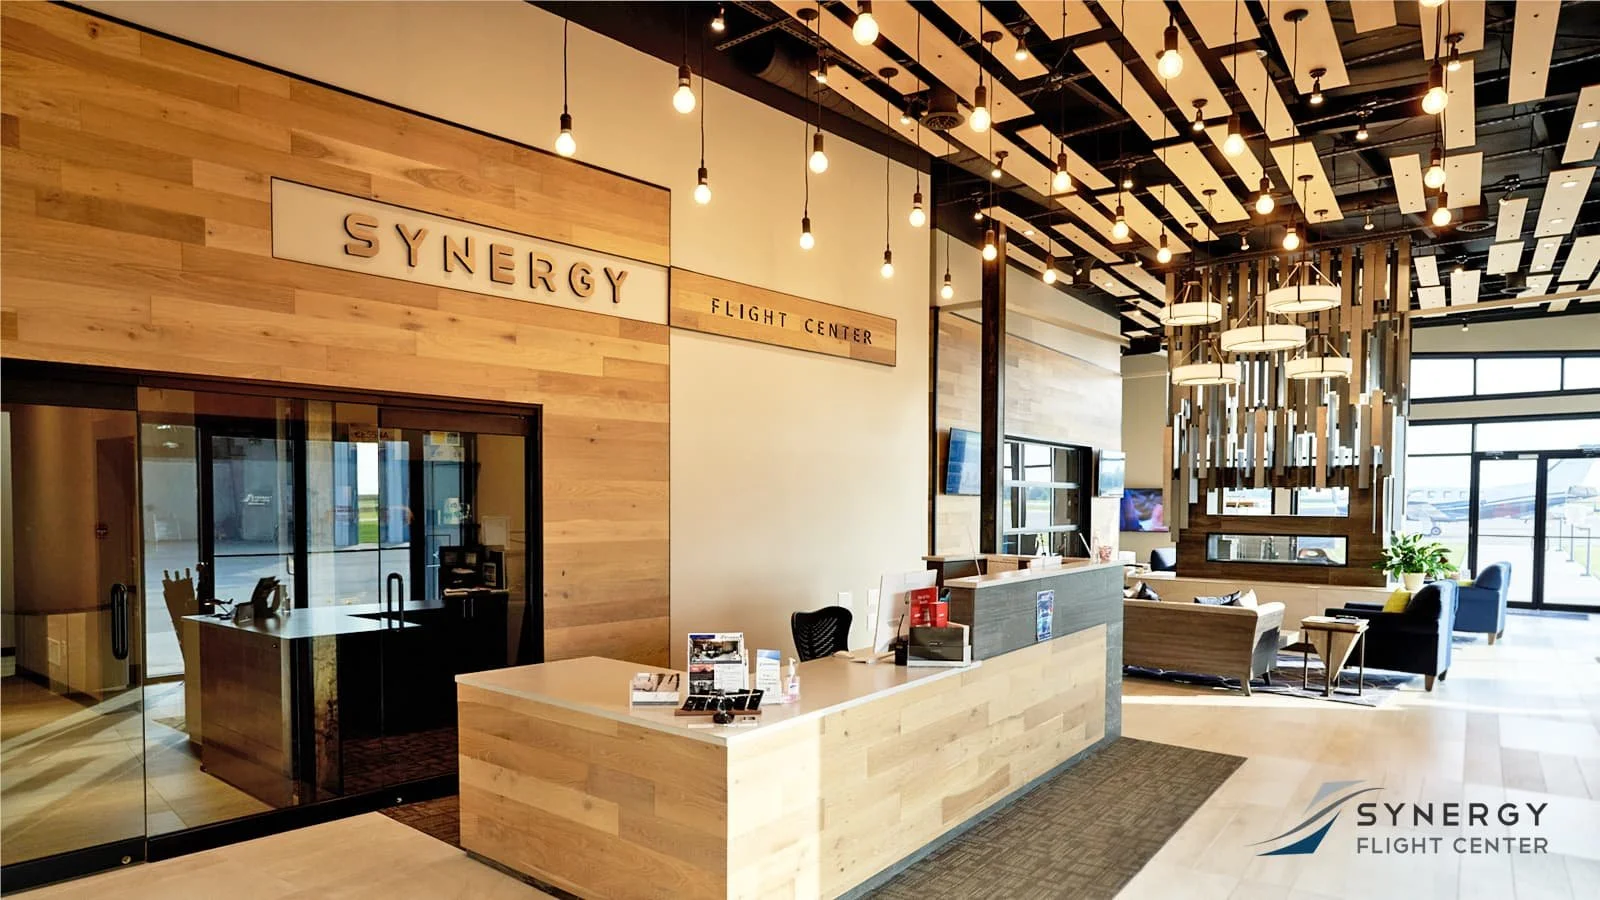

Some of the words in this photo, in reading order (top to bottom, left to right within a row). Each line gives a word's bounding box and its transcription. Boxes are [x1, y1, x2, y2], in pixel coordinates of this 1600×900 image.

[343, 212, 629, 304] SYNERGY
[711, 297, 788, 328] FLIGHT
[804, 318, 873, 345] CENTER
